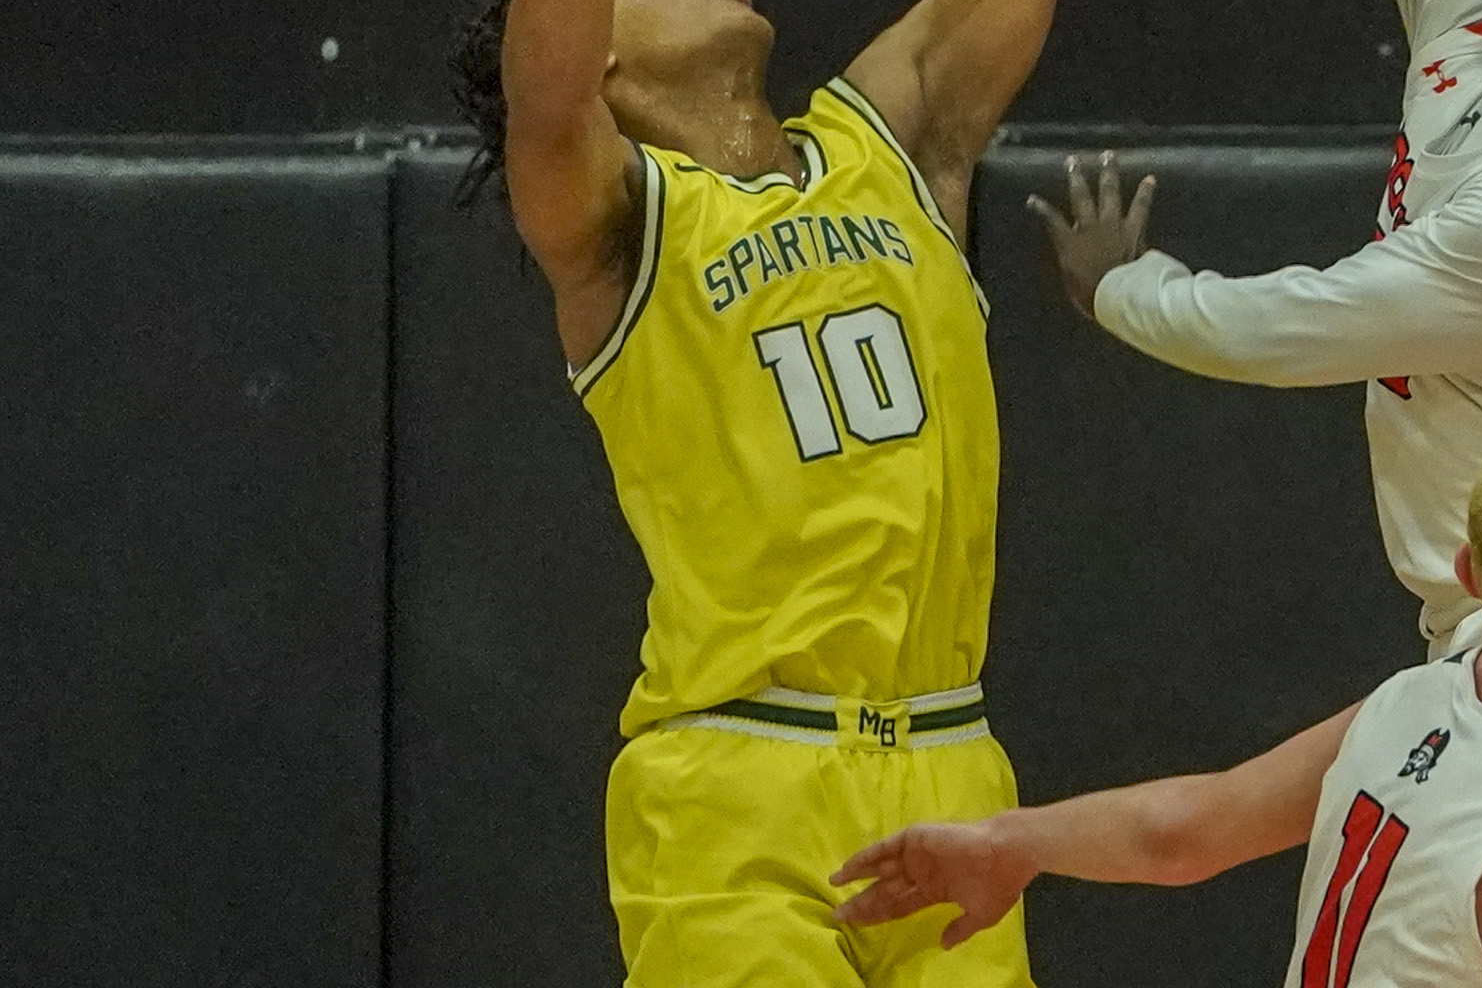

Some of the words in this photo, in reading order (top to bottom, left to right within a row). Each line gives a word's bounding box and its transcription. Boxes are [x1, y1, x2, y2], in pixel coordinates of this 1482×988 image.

[704, 215, 914, 312] SPARTANS
[752, 303, 928, 463] 10
[859, 706, 896, 746] MB
[1301, 789, 1410, 988] 11
